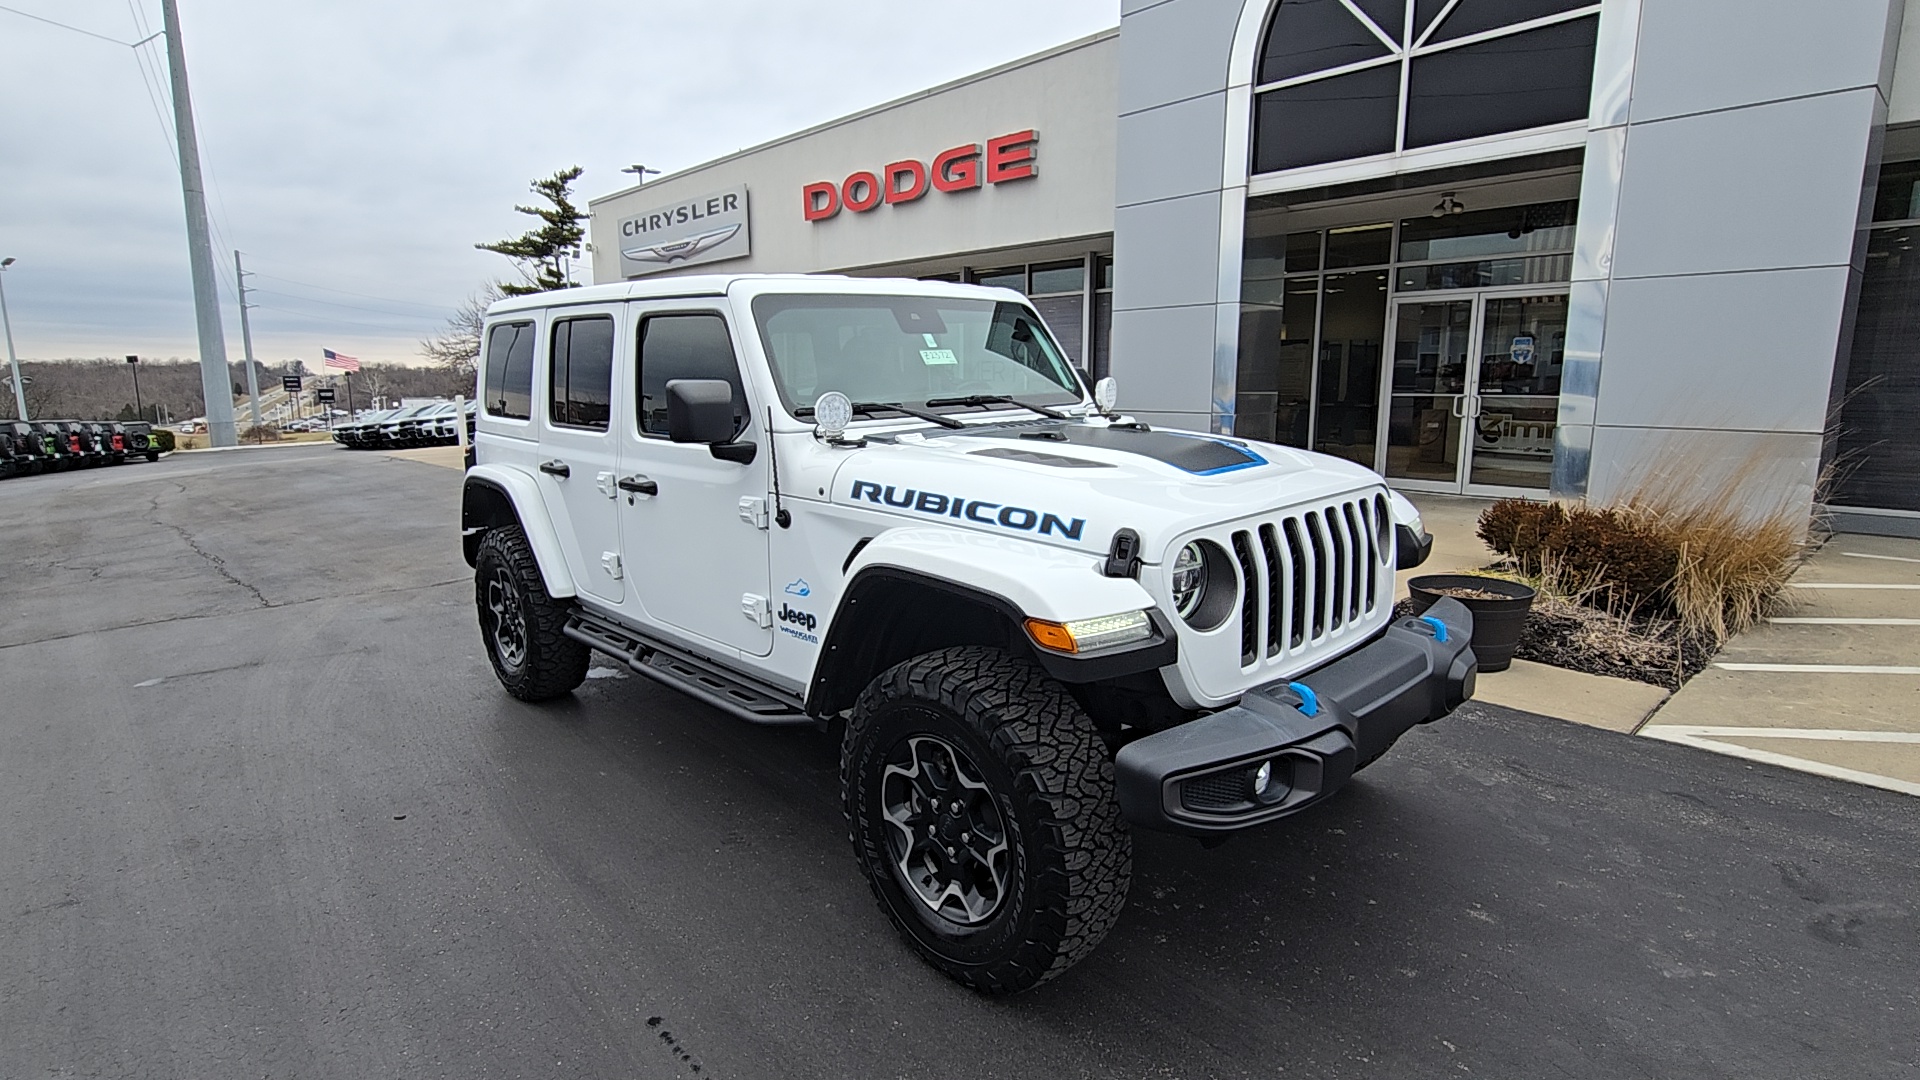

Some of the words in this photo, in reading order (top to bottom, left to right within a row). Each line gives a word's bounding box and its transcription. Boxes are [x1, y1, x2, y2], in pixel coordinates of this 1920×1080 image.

[803, 129, 1039, 222] DODGE
[622, 193, 739, 237] CHRYSLER
[850, 479, 1087, 542] RUBICON
[778, 603, 817, 632] Jeep
